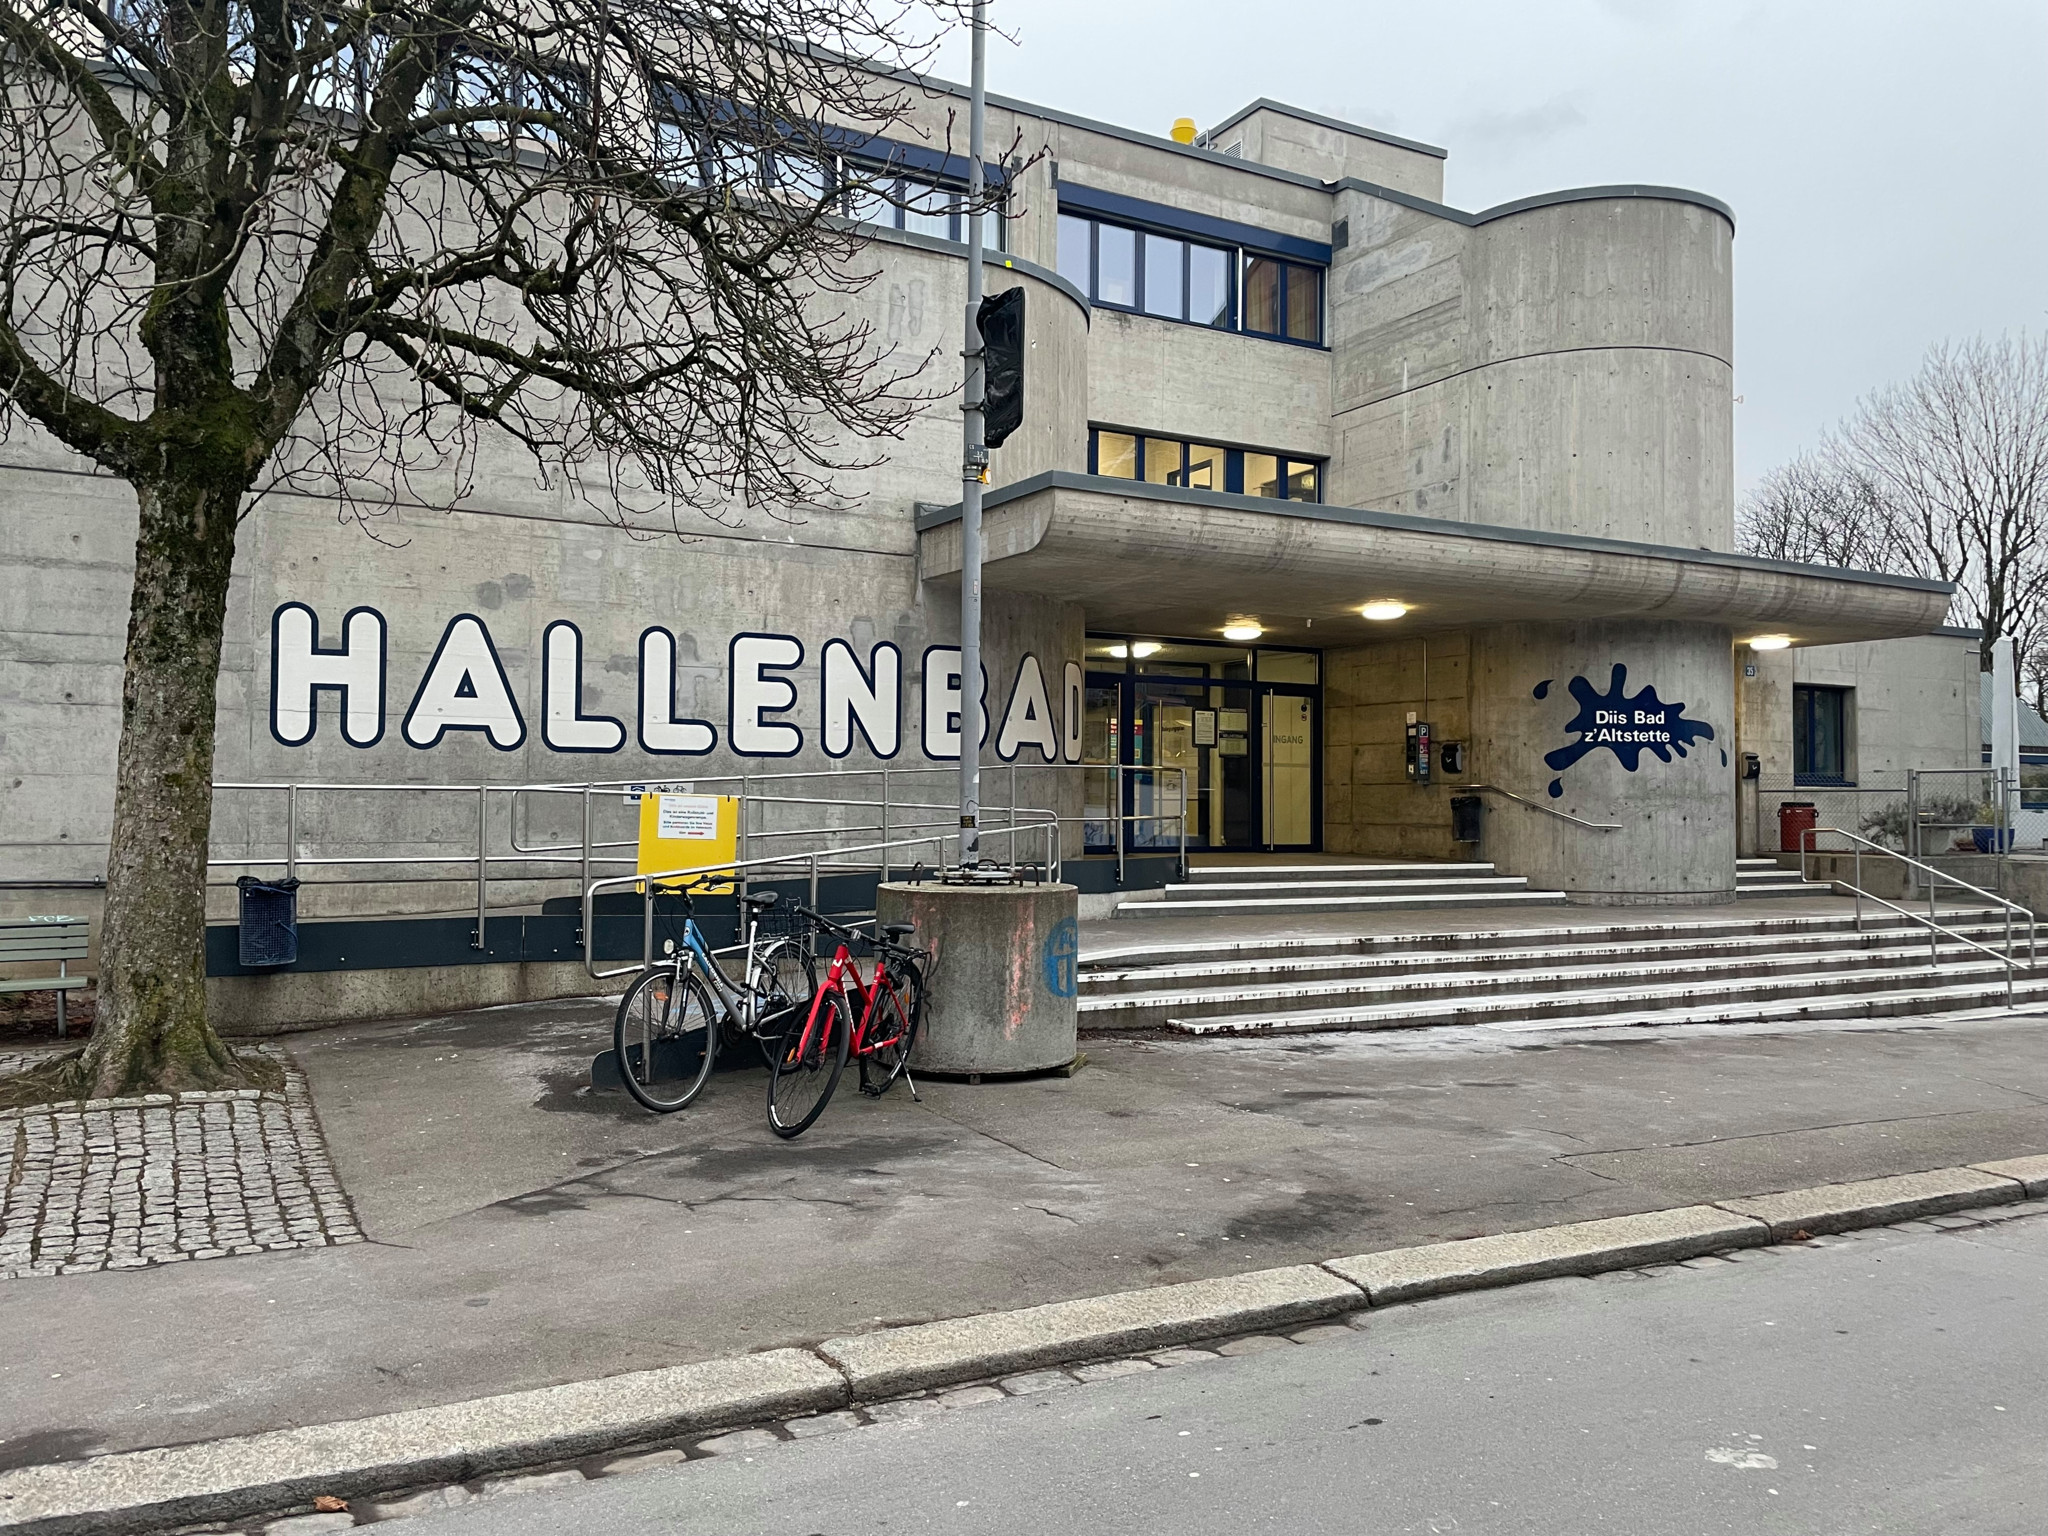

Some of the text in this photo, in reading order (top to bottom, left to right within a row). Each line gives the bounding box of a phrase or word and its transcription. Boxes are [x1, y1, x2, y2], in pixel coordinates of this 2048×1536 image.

[1746, 666, 1754, 676] 35
[270, 602, 1083, 764] HALLENBAD
[1595, 710, 1665, 725] Diis Bad
[1584, 728, 1671, 743] z’Altstette
